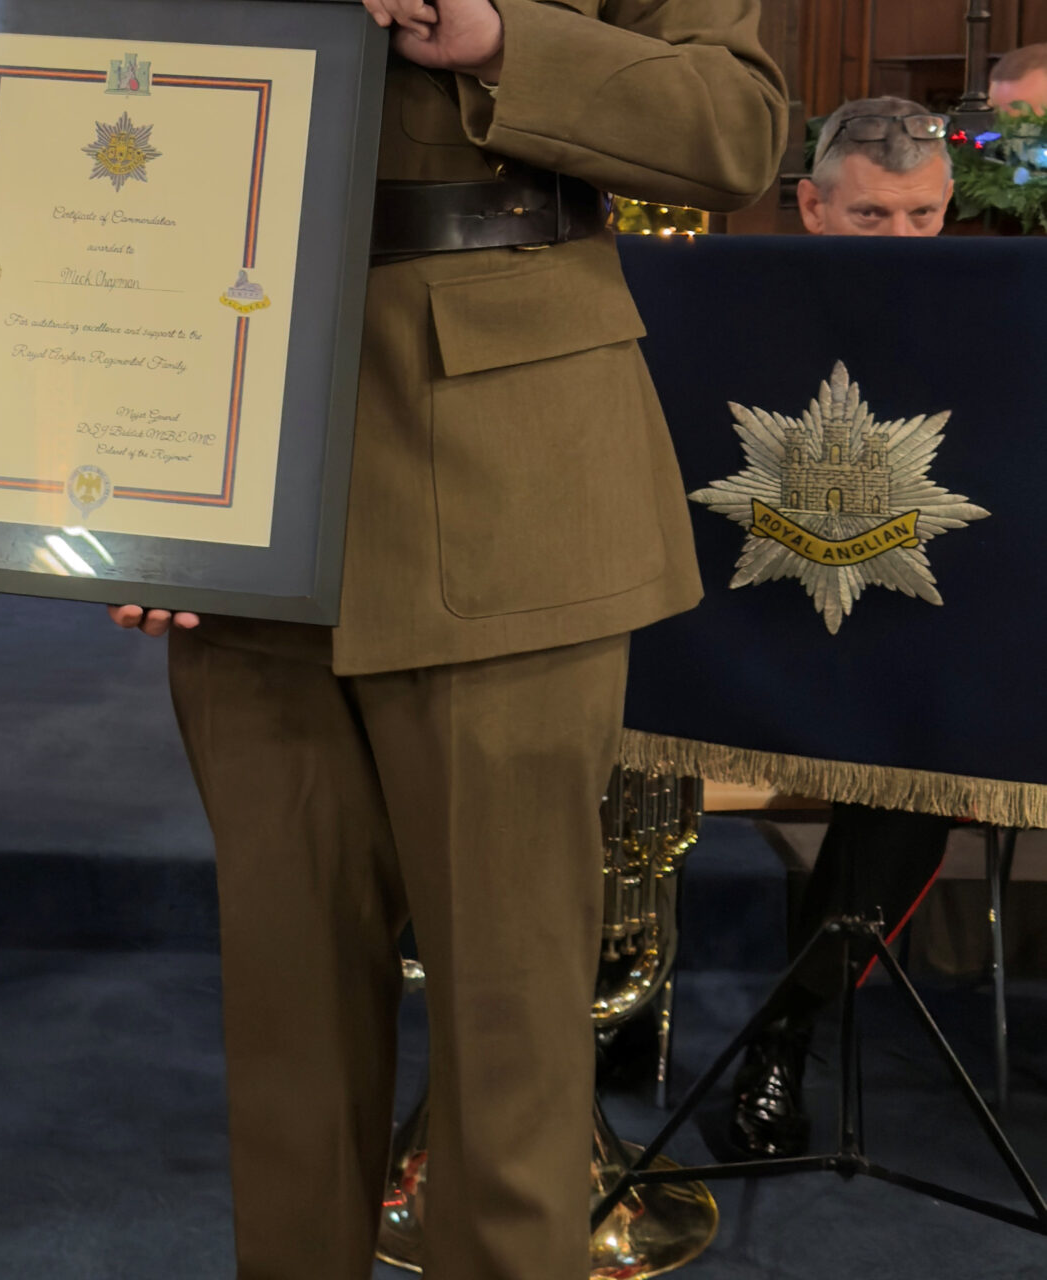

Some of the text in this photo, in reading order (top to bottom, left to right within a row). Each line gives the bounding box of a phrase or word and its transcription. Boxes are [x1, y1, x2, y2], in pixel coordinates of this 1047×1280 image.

[112, 210, 176, 226] Commendation
[759, 513, 911, 562] ROYAL ANGLIAN
